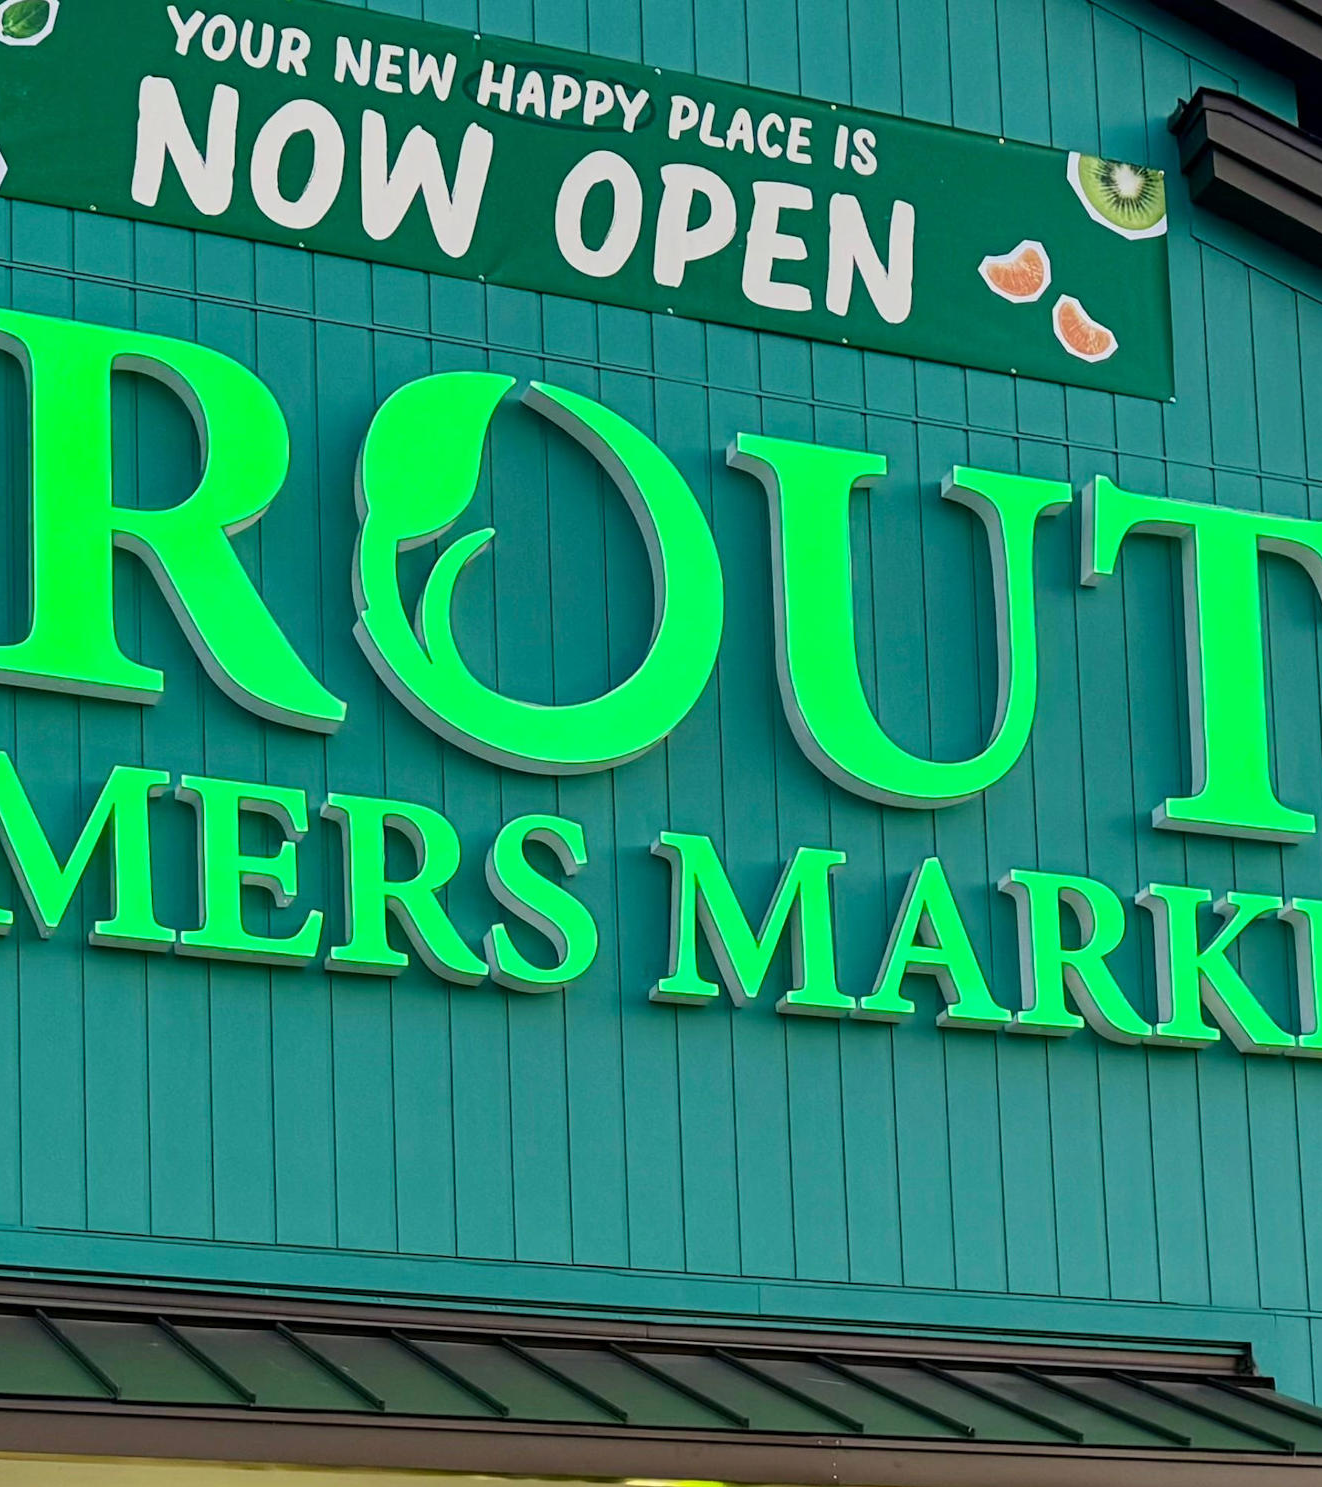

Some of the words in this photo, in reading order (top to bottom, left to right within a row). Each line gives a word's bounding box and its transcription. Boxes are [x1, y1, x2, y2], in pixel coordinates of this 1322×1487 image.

[165, 5, 312, 78] YOUR
[333, 36, 458, 103] NEW
[475, 60, 651, 134] HAPPY
[667, 94, 814, 165] PLACE
[833, 125, 879, 177] IS
[130, 75, 495, 259] NOW
[554, 149, 916, 325] OPEN
